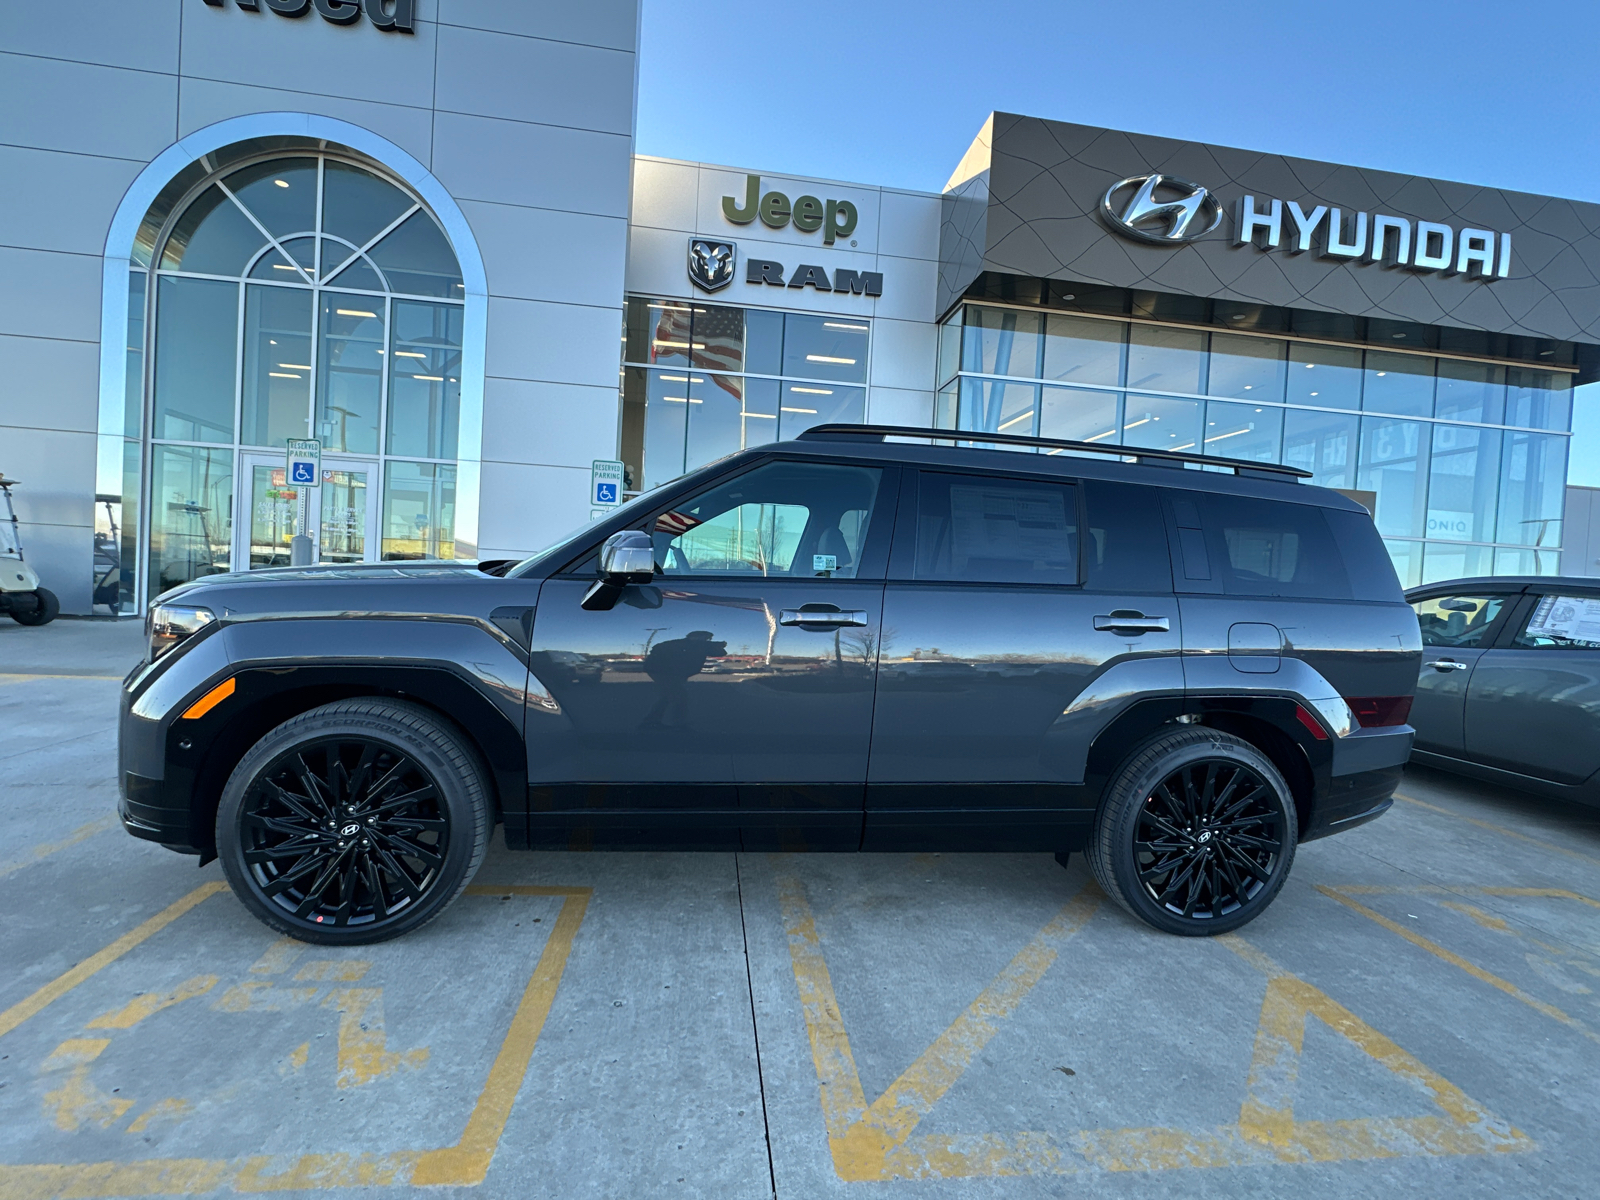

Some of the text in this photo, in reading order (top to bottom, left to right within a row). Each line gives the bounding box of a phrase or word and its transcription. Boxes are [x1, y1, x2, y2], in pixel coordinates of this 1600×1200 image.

[722, 174, 858, 245] Jeep
[1236, 195, 1511, 279] HYUNDAI
[746, 258, 883, 297] RAM
[290, 442, 318, 450] RESERVED
[290, 450, 318, 458] PARKING
[595, 464, 620, 472] RESERVED
[321, 718, 402, 735] SCORPION
